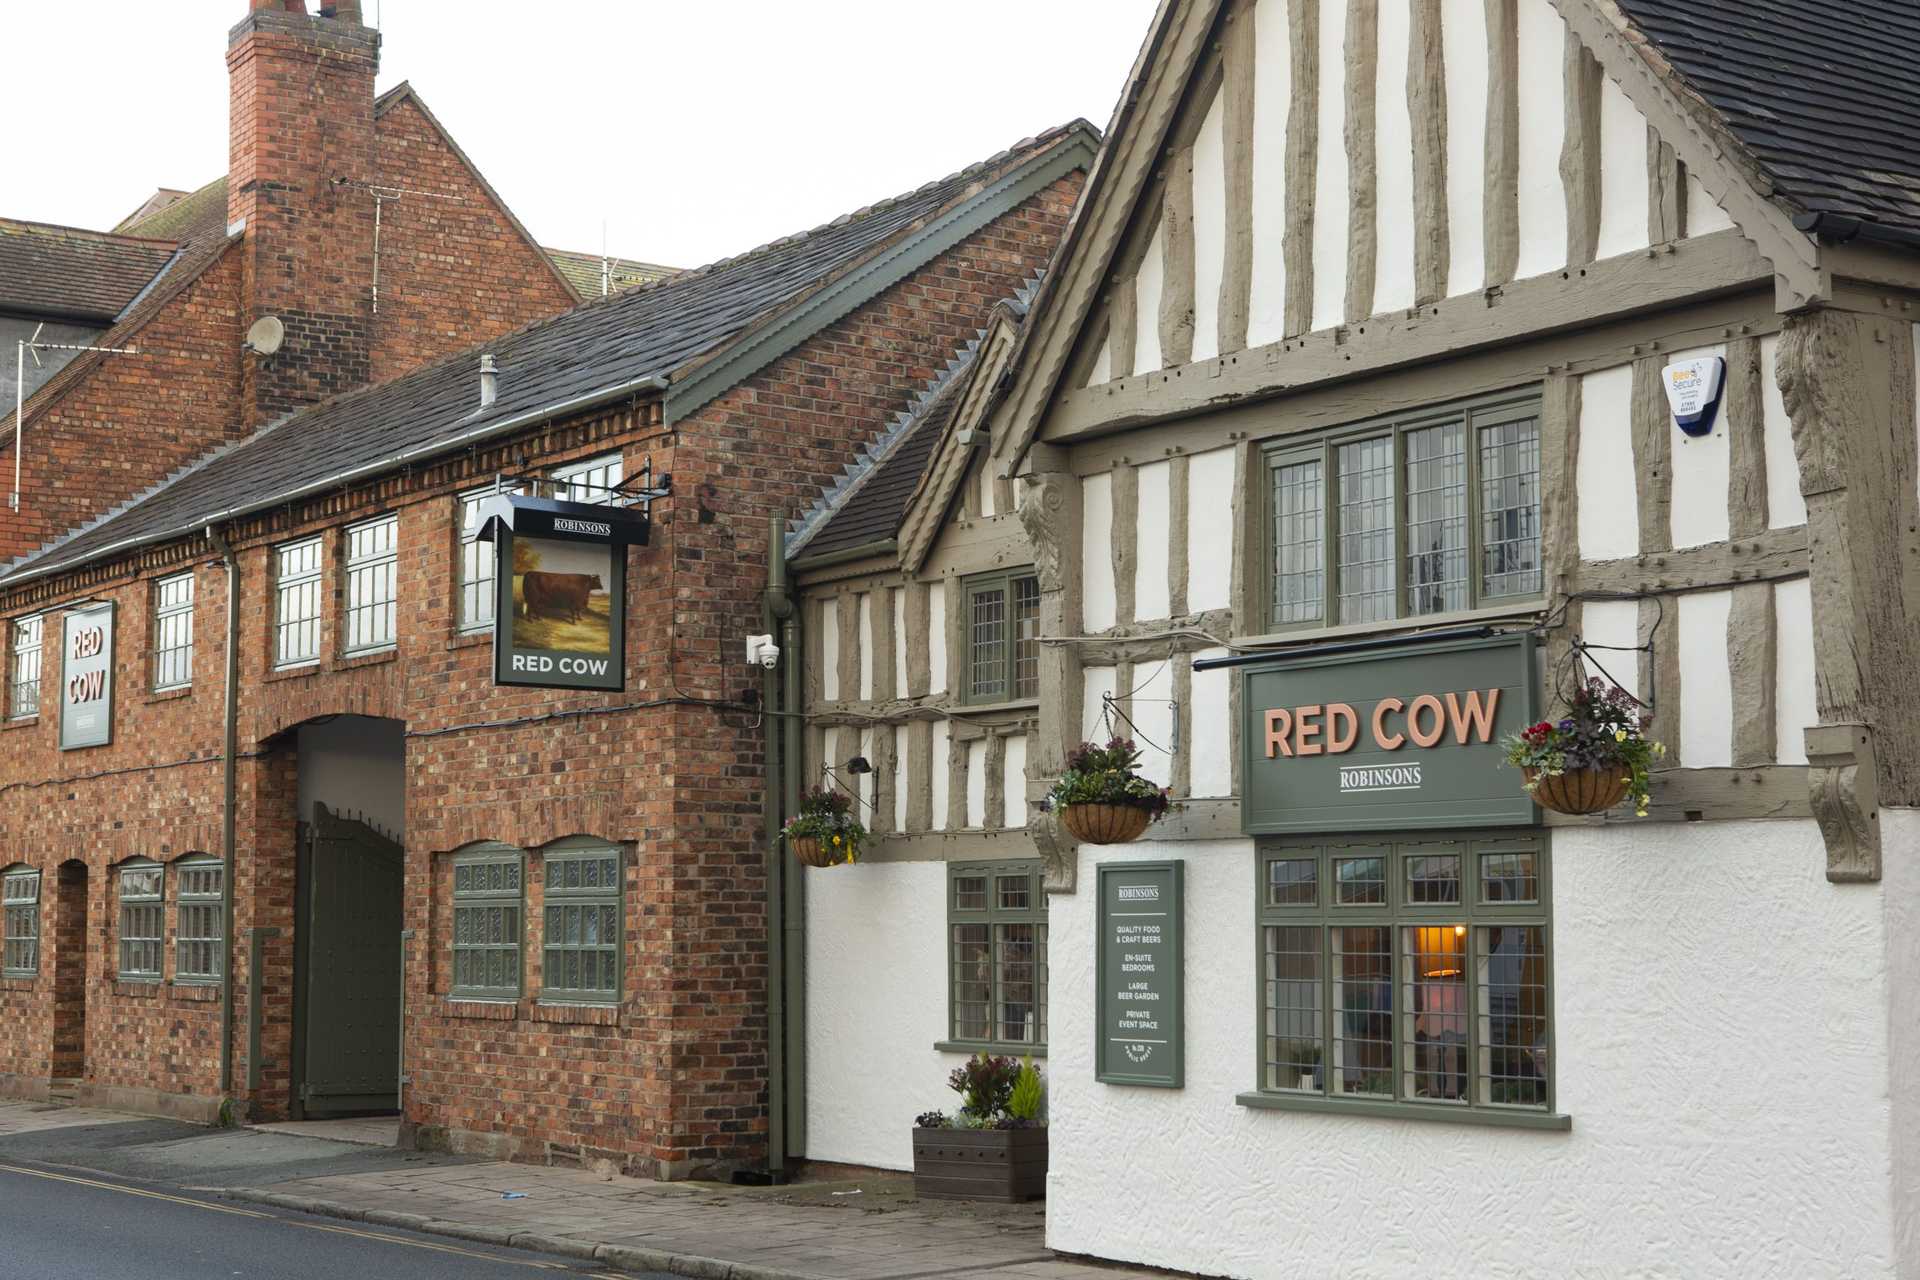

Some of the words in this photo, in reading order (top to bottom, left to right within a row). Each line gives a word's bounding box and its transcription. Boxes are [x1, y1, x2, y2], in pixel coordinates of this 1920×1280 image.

[553, 518, 612, 536] ROBINSONS
[72, 625, 103, 660] RED
[512, 654, 553, 673] RED
[559, 657, 609, 676] COW
[68, 669, 106, 705] COW
[1264, 702, 1360, 759] RED
[1372, 688, 1501, 751] COW
[1340, 766, 1422, 789] ROBINSONS
[1118, 887, 1160, 898] ROBINSONS
[1116, 925, 1142, 934] QUALITY
[1143, 925, 1161, 934] FOOD
[1116, 935, 1121, 944] &
[1121, 935, 1141, 944] CRAFT
[1142, 935, 1161, 944] BEERS
[1124, 953, 1152, 962] EN-SUITE
[1122, 963, 1155, 972] BEDROOMS
[1128, 982, 1149, 991] LARGE
[1118, 991, 1133, 1000] BEER
[1134, 992, 1160, 1001] GARDEN
[1126, 1010, 1151, 1019] PRIVATE
[1119, 1020, 1138, 1029] EVENT
[1139, 1021, 1158, 1030] SPACE
